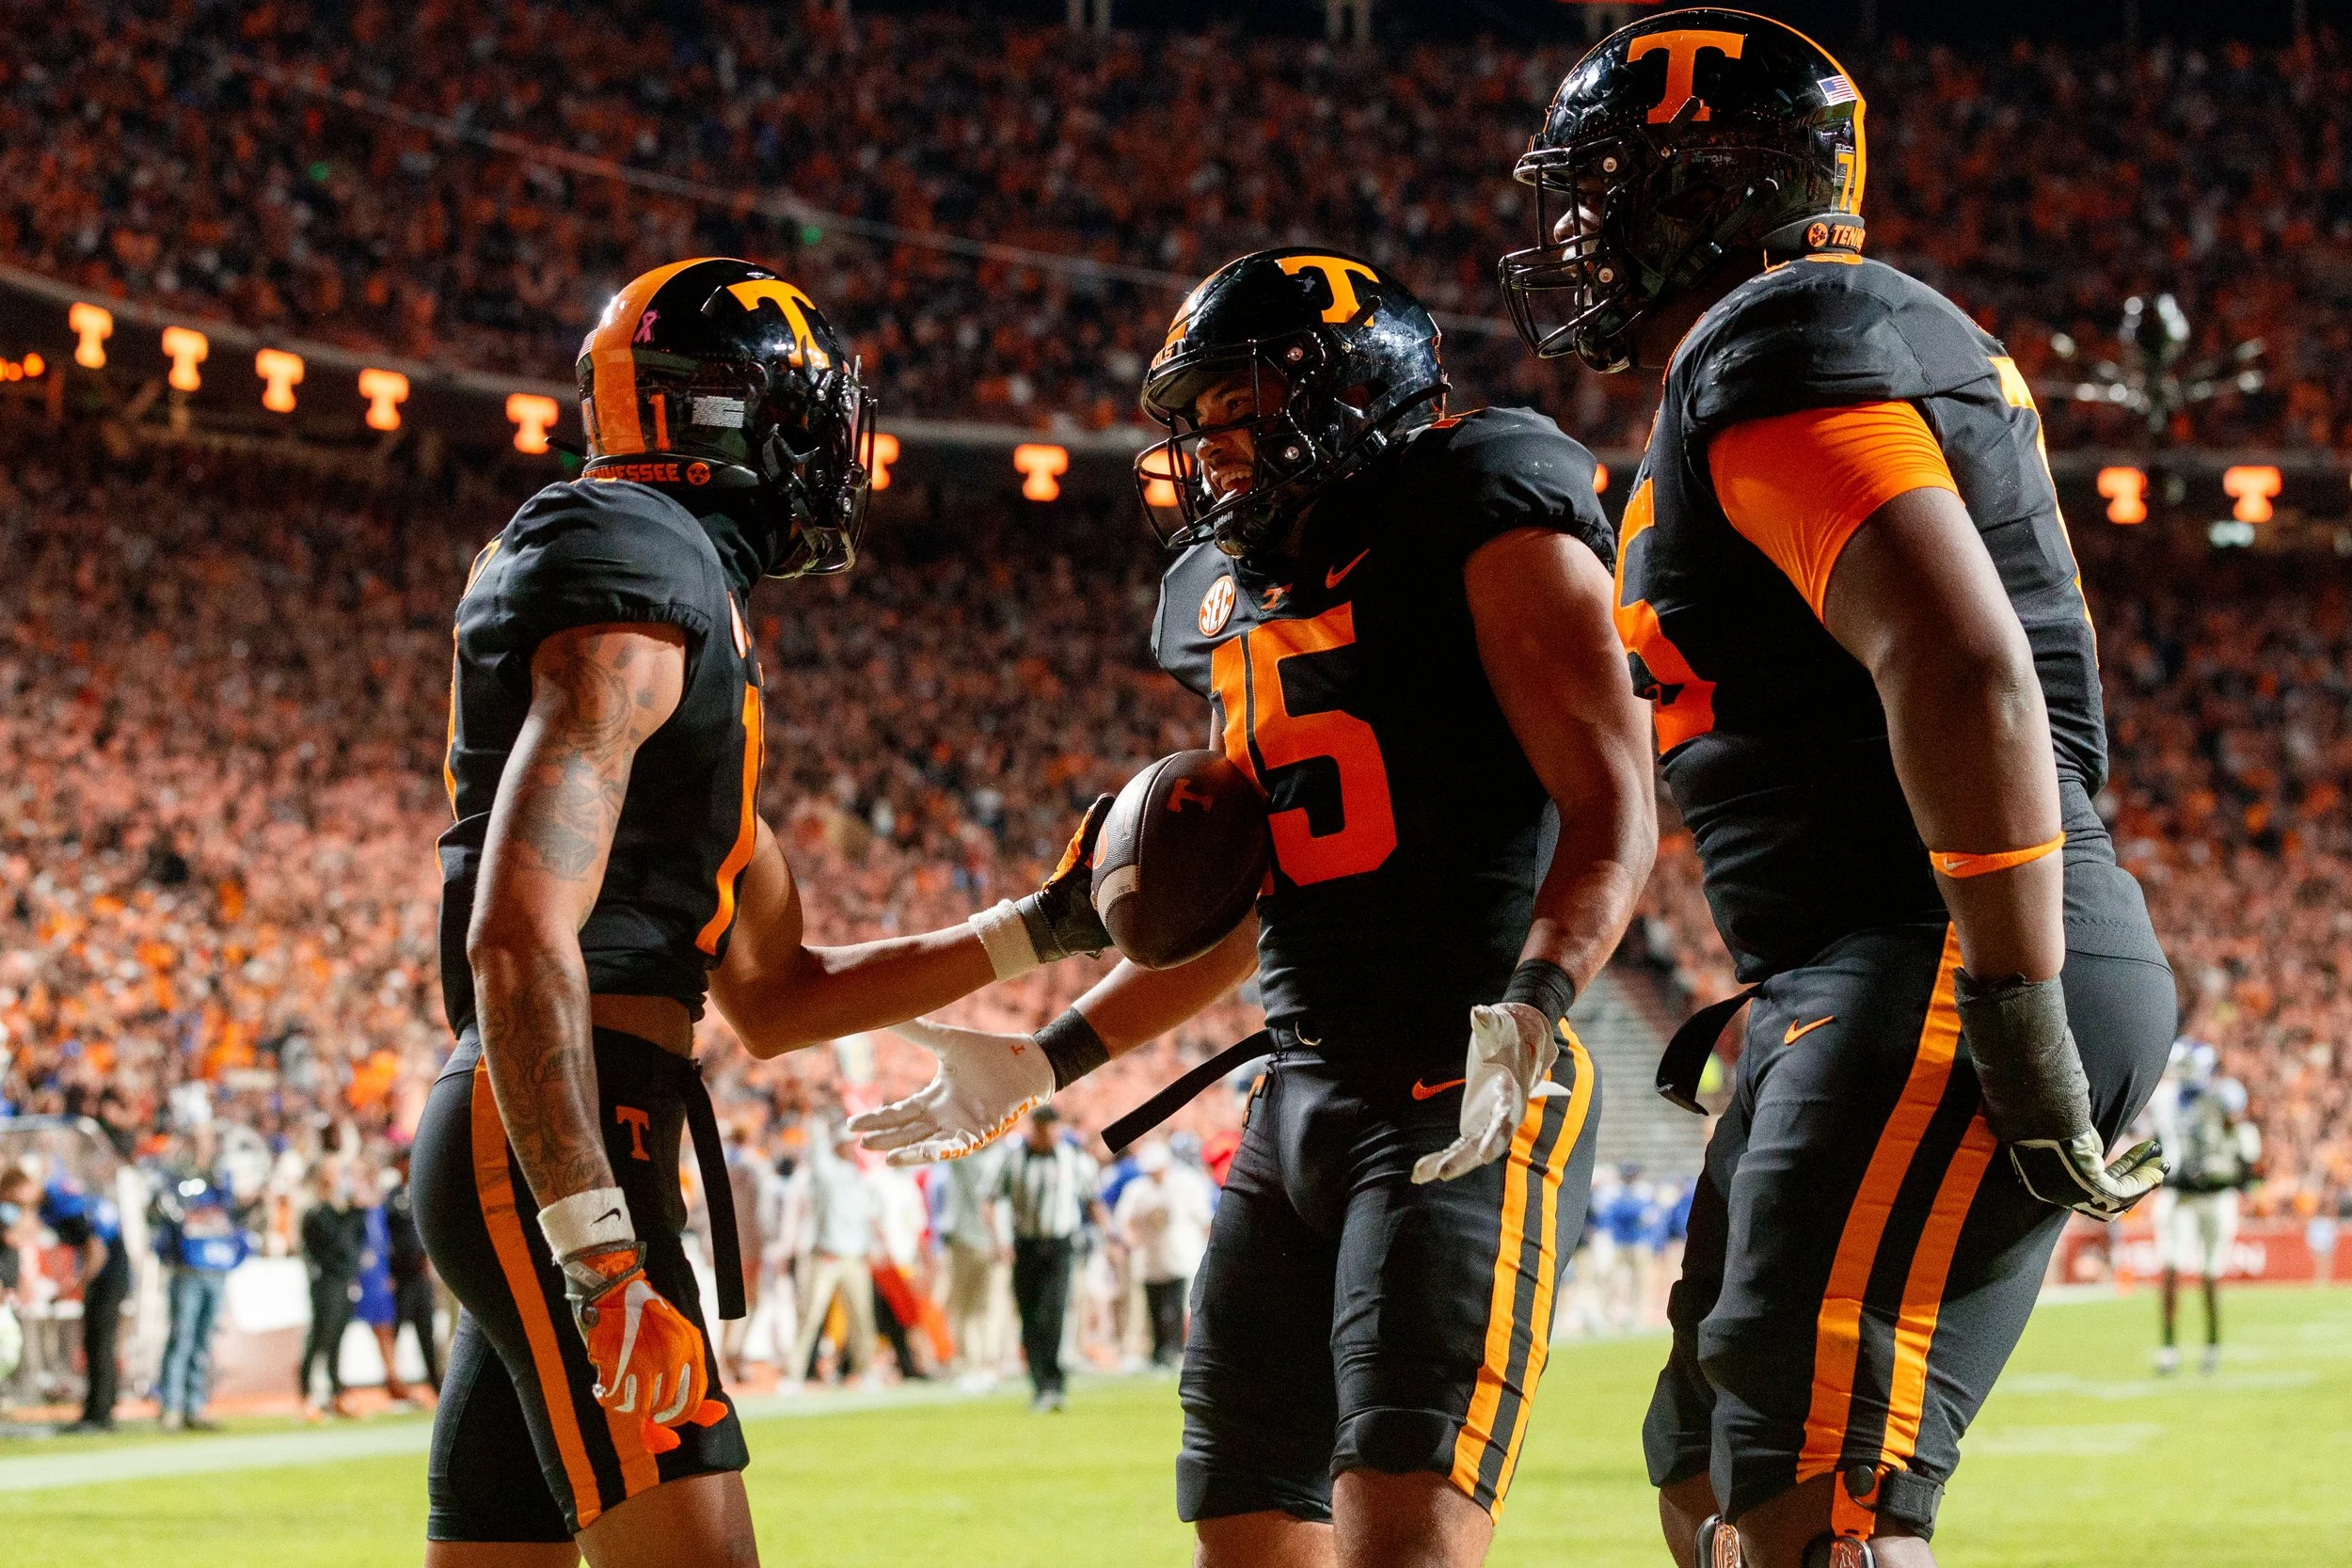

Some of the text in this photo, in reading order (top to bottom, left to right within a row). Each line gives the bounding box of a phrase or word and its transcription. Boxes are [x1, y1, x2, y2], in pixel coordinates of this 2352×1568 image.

[1628, 30, 1744, 123] T
[1838, 152, 1855, 212] 7
[1831, 225, 1866, 253] TENN
[1277, 255, 1381, 327] T
[727, 278, 830, 369] T
[649, 393, 671, 451] 1
[1201, 578, 1233, 633] SEC
[1211, 602, 1397, 895] 15
[1167, 777, 1214, 814] T
[616, 1105, 650, 1162] T
